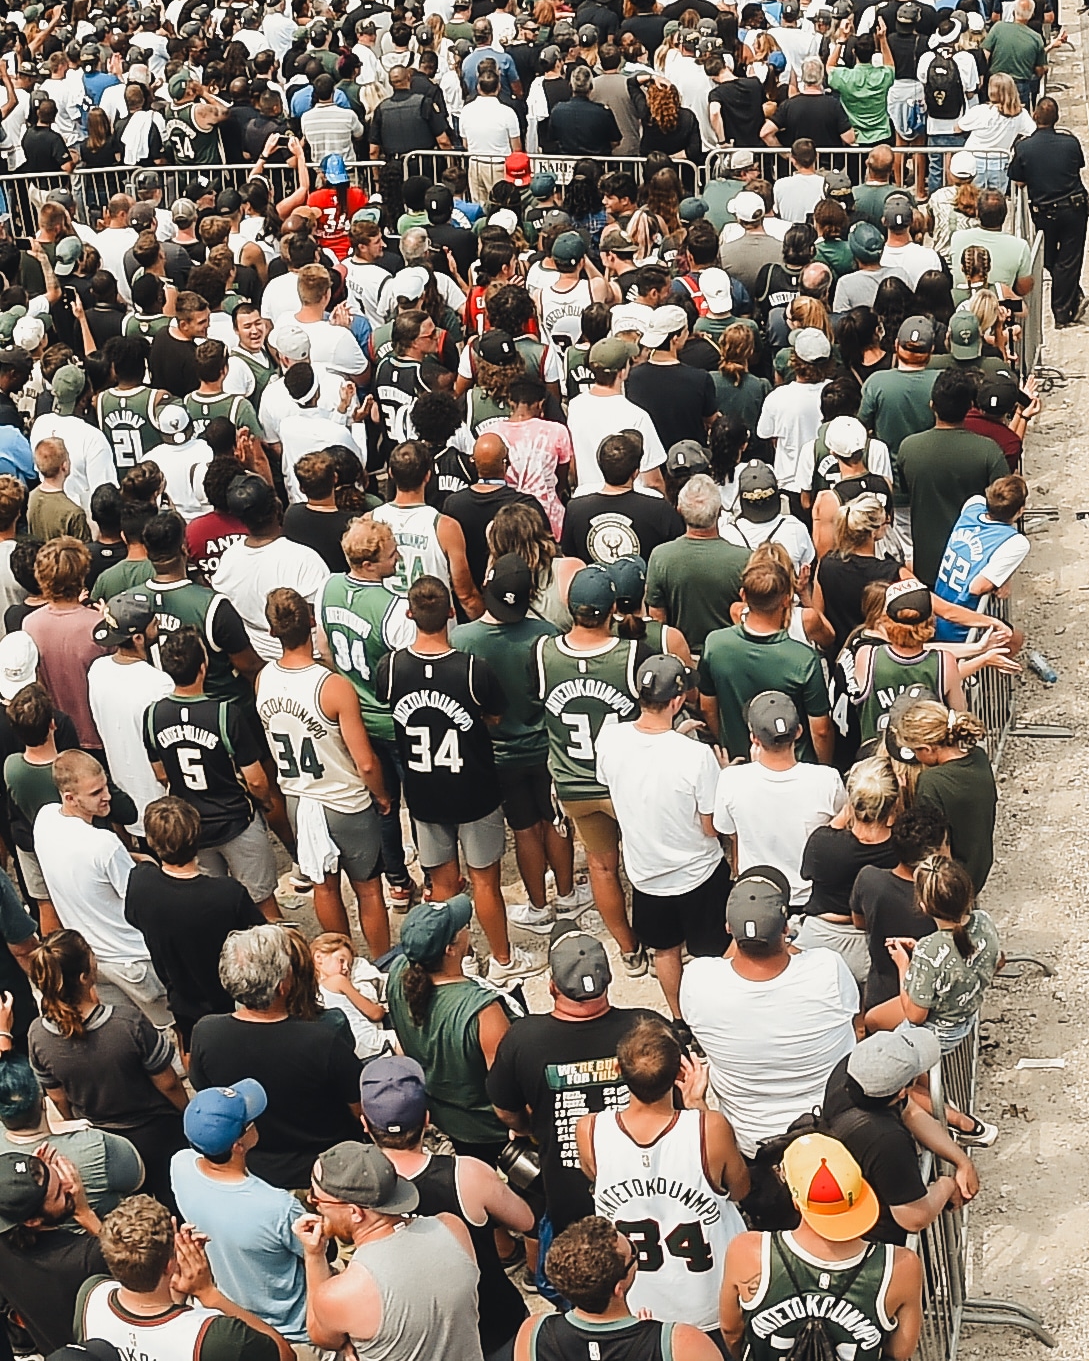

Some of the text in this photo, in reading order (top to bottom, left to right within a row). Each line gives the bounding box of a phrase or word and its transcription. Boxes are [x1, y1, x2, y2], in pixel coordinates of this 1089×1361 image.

[171, 136, 195, 158] 34
[323, 208, 350, 233] 34
[105, 410, 146, 429] HOLIDAY
[111, 429, 143, 468] 21
[939, 547, 971, 593] 22
[331, 630, 371, 681] 34
[393, 689, 474, 732] ANTETOKOUNMPO
[545, 679, 635, 717] ANTETOKOUNMPO
[176, 747, 208, 790] 5
[271, 733, 325, 780] 34
[405, 726, 464, 773] 34
[557, 1061, 595, 1077] WE'RE
[566, 1068, 618, 1085] FOR THIS
[596, 1177, 721, 1226] ANTETOKOUNMPO
[614, 1218, 715, 1273] 34
[750, 1294, 882, 1351] ANTETOKOUNMPO
